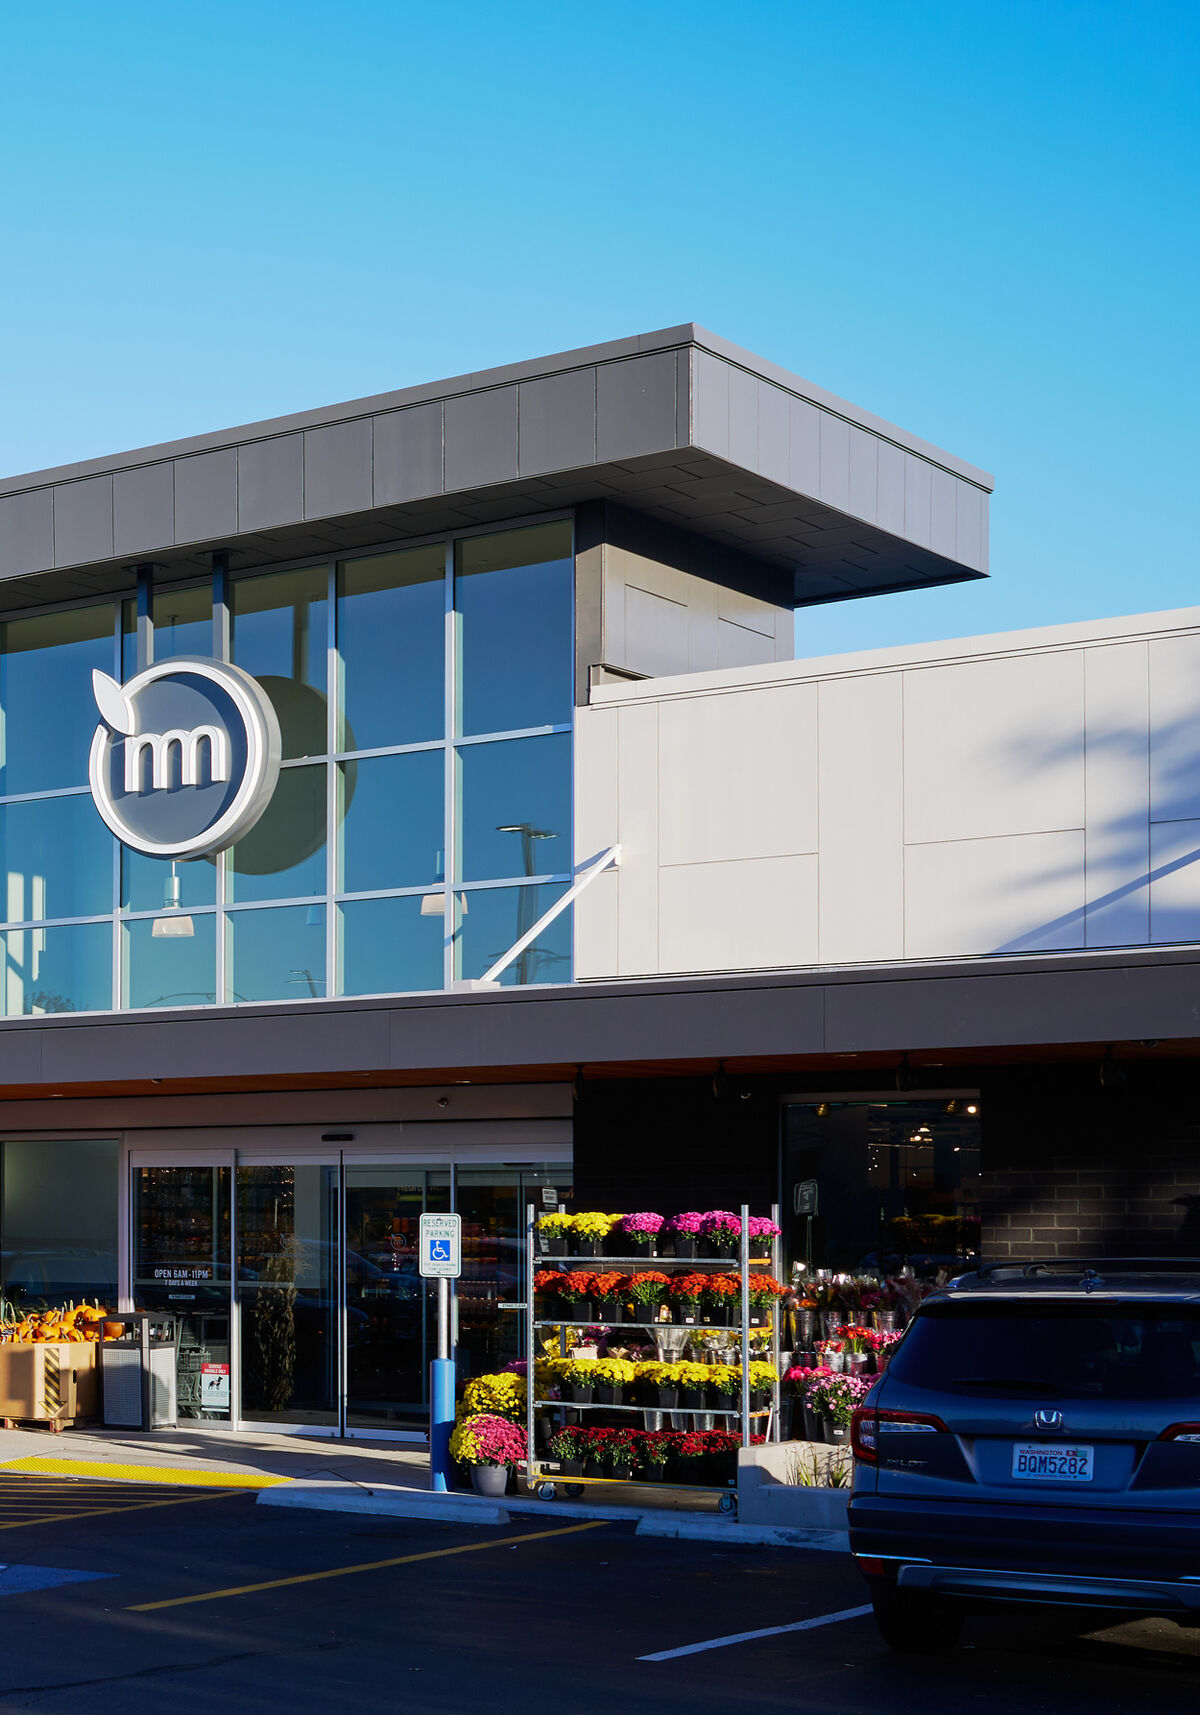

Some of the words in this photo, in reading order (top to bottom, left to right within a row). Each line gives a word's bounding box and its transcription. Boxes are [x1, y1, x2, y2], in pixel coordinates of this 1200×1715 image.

[125, 725, 226, 792] m
[423, 1218, 457, 1228] RESERVED
[425, 1229, 455, 1239] PARKING
[154, 1269, 172, 1279] OPEN
[185, 1279, 199, 1287] WEEK
[1018, 1455, 1088, 1475] BQM5282
